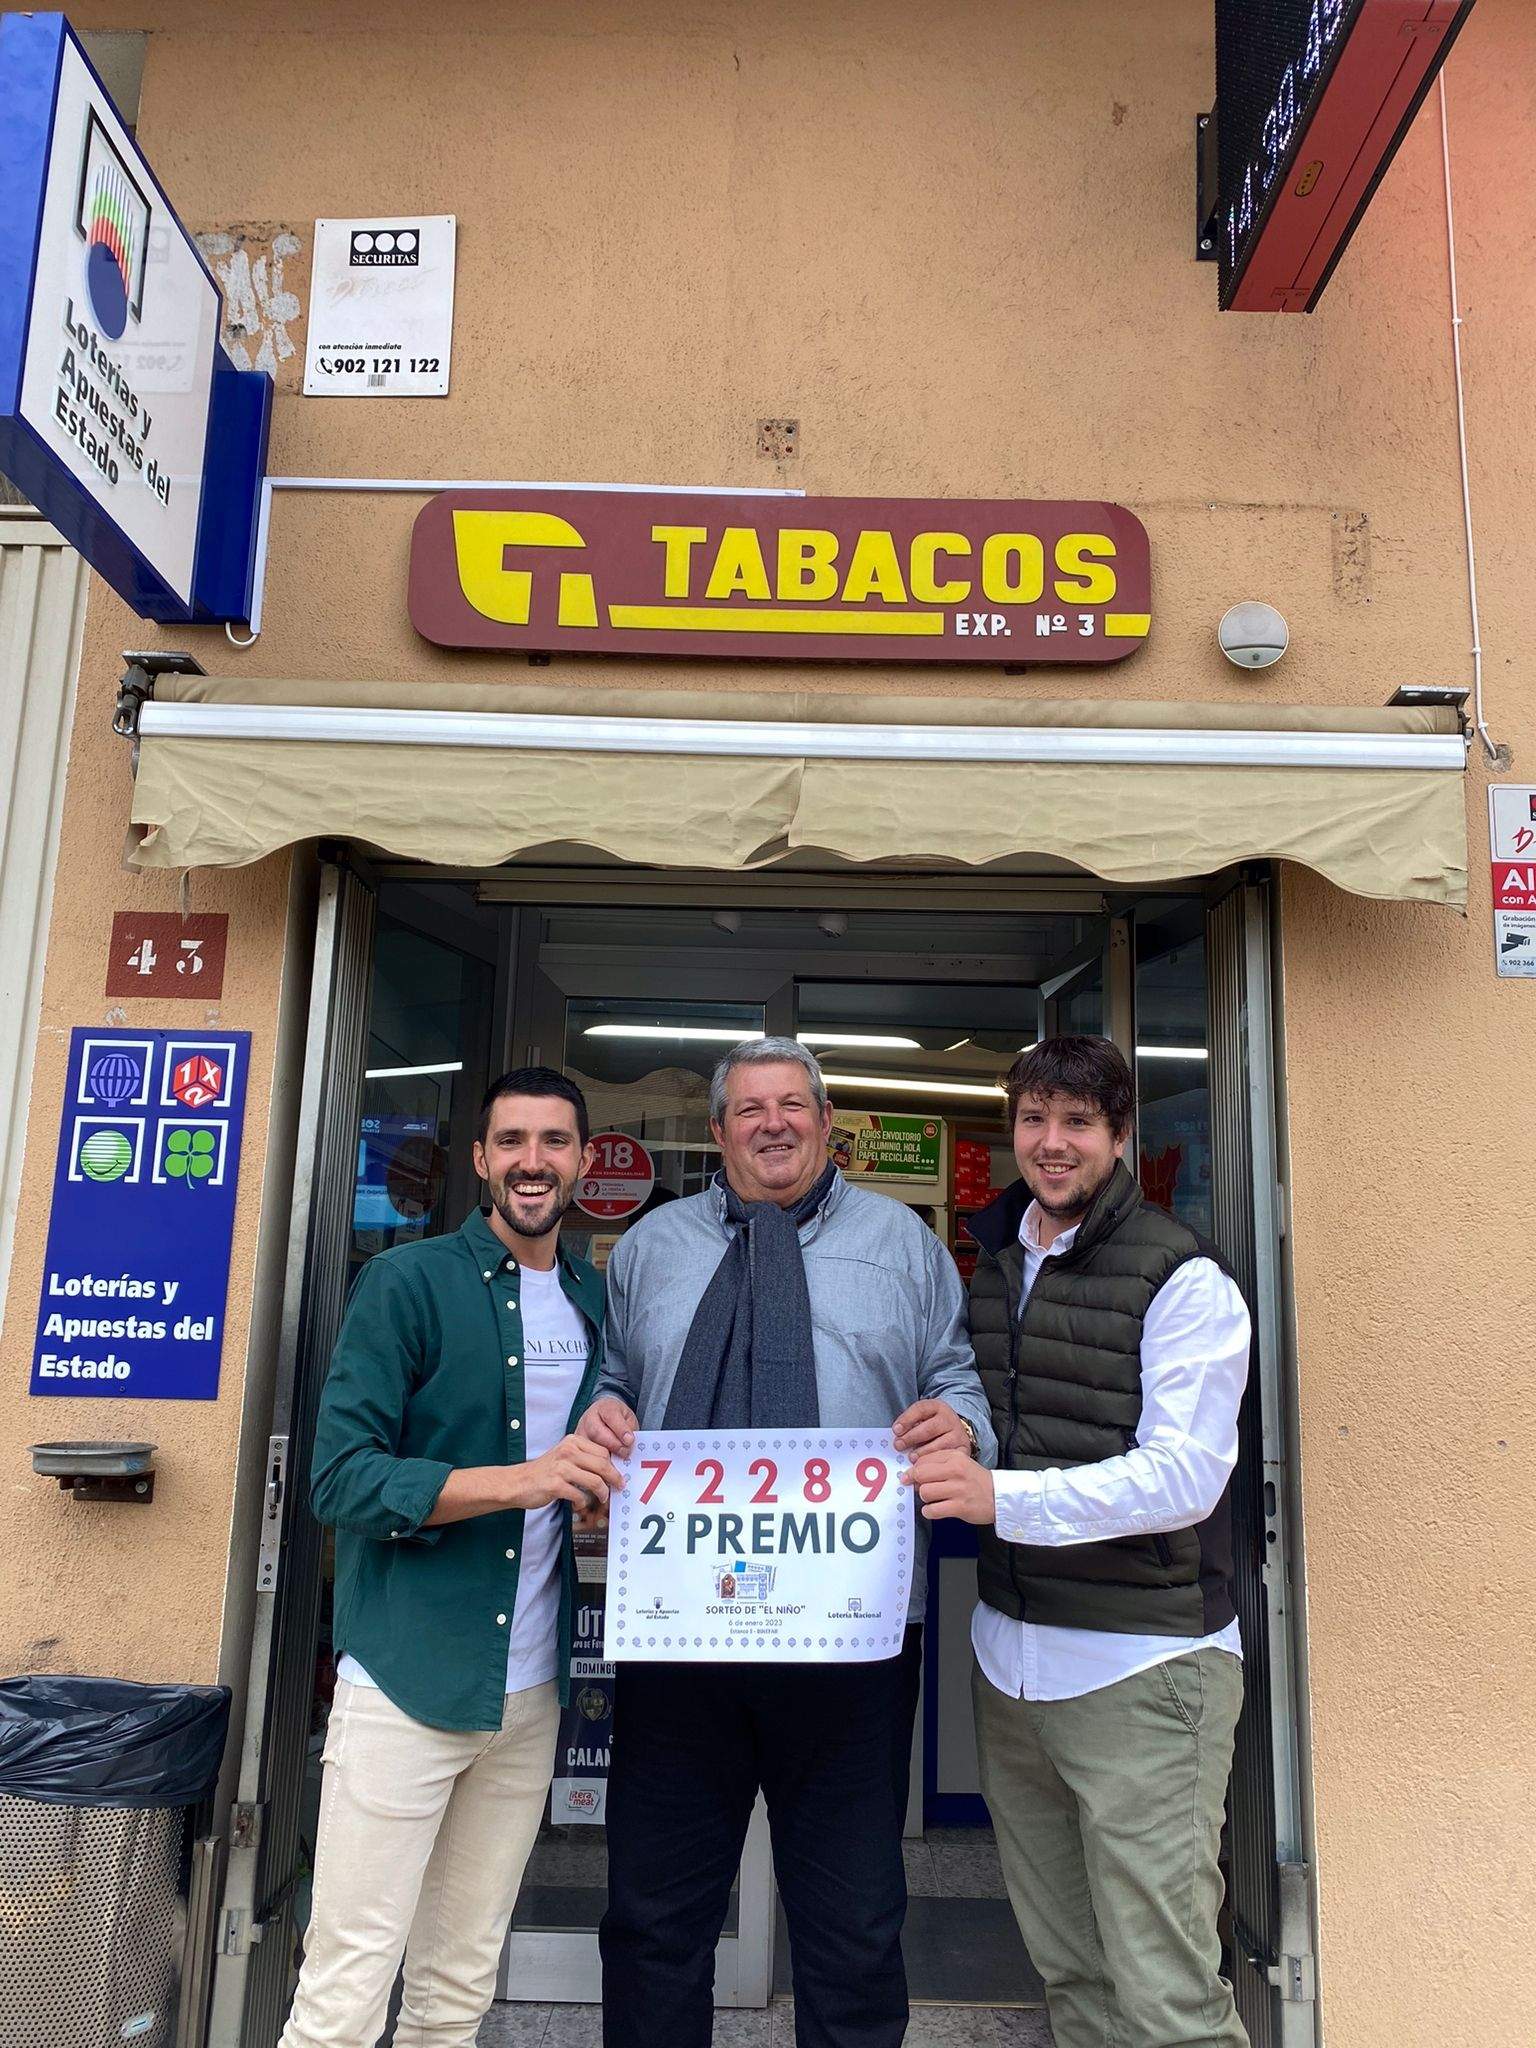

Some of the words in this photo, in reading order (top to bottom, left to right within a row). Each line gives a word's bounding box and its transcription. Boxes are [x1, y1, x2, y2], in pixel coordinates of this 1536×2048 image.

[352, 254, 417, 265] SECURITAS
[334, 359, 366, 373] 902
[373, 359, 401, 373] 121
[409, 358, 440, 373] 122
[54, 385, 119, 485] Estado
[59, 347, 144, 471] Apuestas
[147, 458, 171, 505] del
[140, 409, 152, 441] y
[652, 525, 1117, 604] TABACOS
[955, 613, 1011, 636] EXP.
[1077, 614, 1095, 636] 3
[1502, 896, 1524, 905] con
[859, 1140, 868, 1149] DE
[903, 1143, 921, 1152] HOLA
[882, 1131, 921, 1142] ENVOLTORIO
[858, 1151, 879, 1160] PAPEL
[49, 1273, 156, 1298] Loterías
[161, 1281, 179, 1305] y
[43, 1313, 166, 1343] Apuestas
[173, 1315, 214, 1341] del
[39, 1354, 131, 1379] Estado
[686, 1511, 880, 1554] PREMIO
[706, 1605, 742, 1614] SORTEO
[744, 1606, 756, 1614] DE
[759, 1605, 773, 1614] "EL
[776, 1604, 806, 1614] NIÑO"
